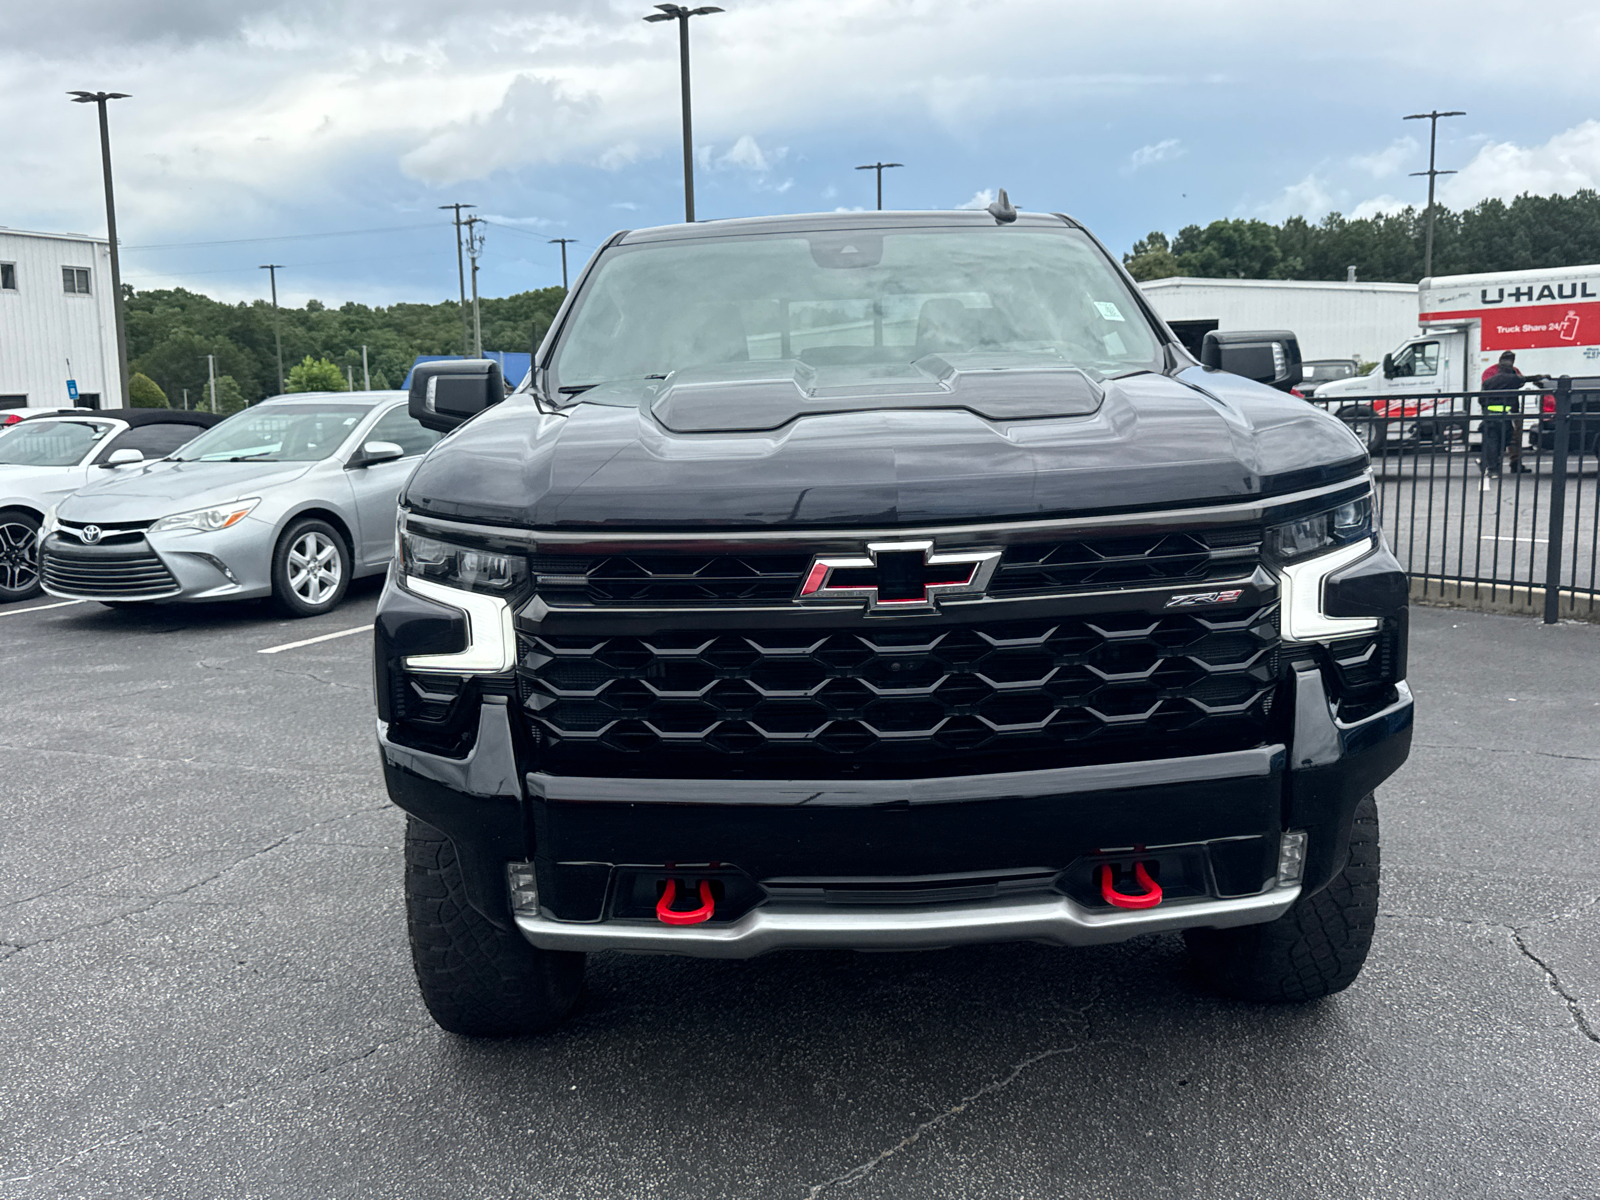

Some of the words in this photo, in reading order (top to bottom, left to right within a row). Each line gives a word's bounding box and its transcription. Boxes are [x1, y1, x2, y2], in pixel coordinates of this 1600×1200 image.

[1481, 282, 1597, 304] U-HAUL
[1496, 325, 1520, 333] Truck
[1522, 324, 1547, 332] Share
[1548, 321, 1570, 331] 24/7
[1164, 590, 1243, 607] ZR2
